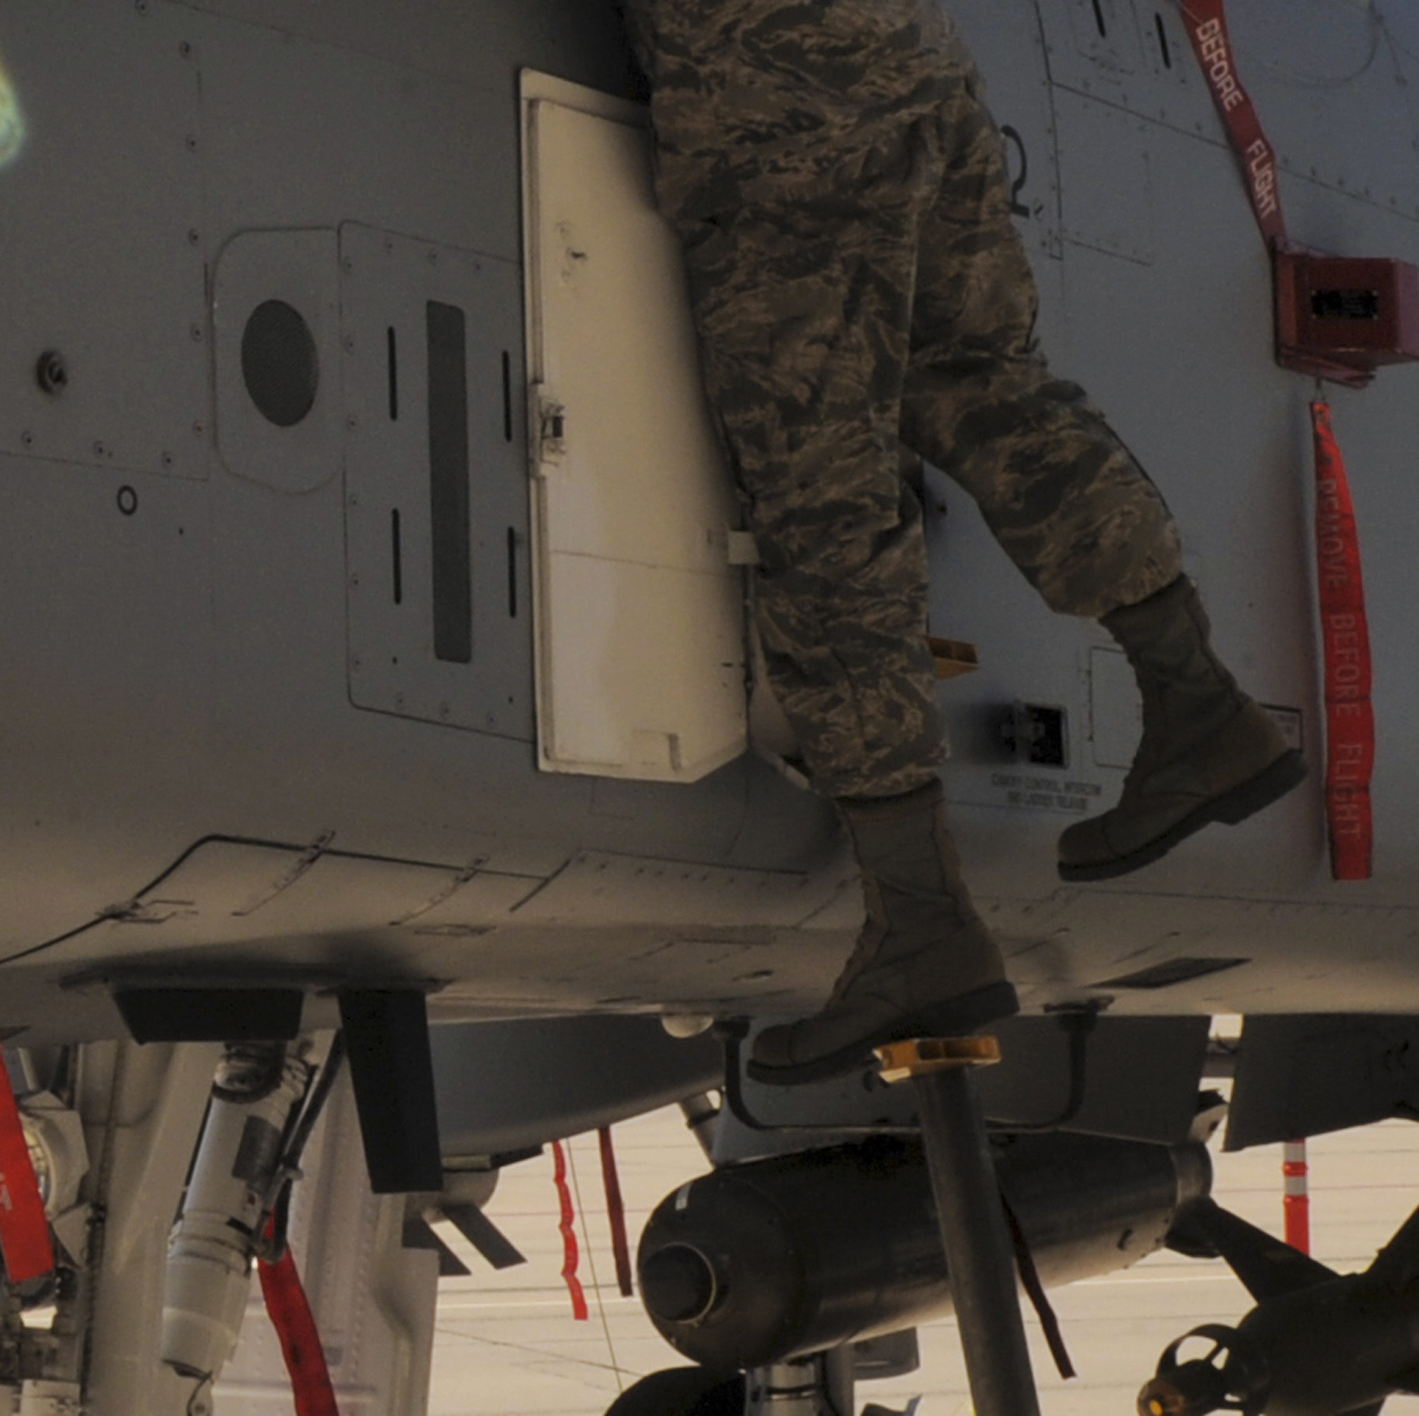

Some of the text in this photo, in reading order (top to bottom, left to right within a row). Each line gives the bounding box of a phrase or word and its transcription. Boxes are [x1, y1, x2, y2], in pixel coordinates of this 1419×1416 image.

[1196, 17, 1244, 112] BEFORE
[1247, 138, 1278, 220] FLIGHT
[1329, 613, 1362, 718] BEFORE
[1333, 743, 1363, 838] FLIGHT
